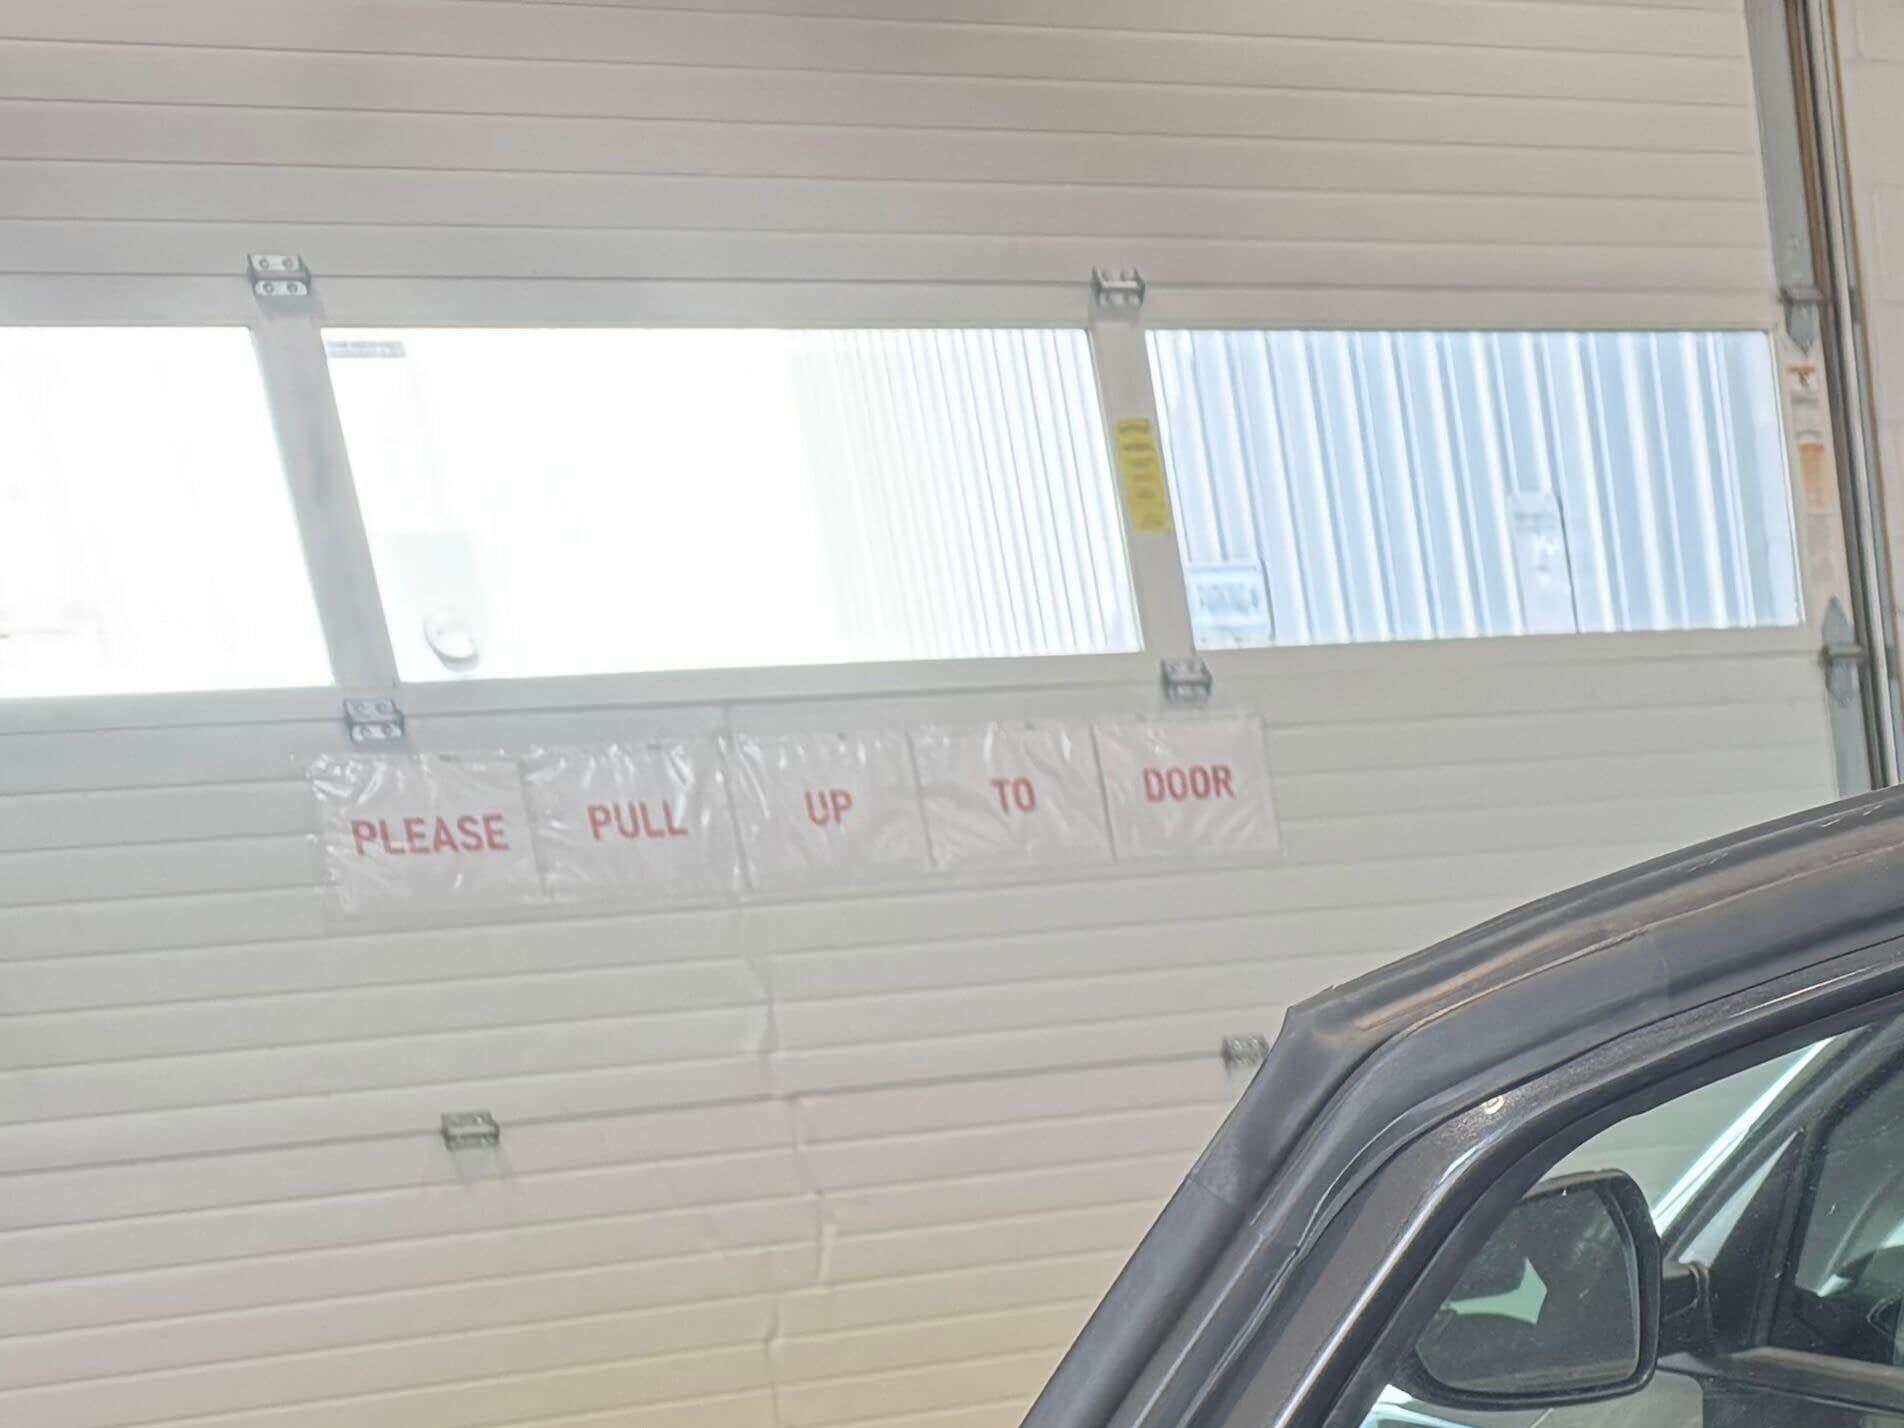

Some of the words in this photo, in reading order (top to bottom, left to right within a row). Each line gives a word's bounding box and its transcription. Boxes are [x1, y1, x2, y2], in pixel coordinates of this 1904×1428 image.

[351, 813, 509, 857] PLEASE
[588, 797, 687, 841] PULL
[806, 789, 853, 827] UP
[991, 776, 1037, 815] TO
[1144, 763, 1233, 805] DOOR
